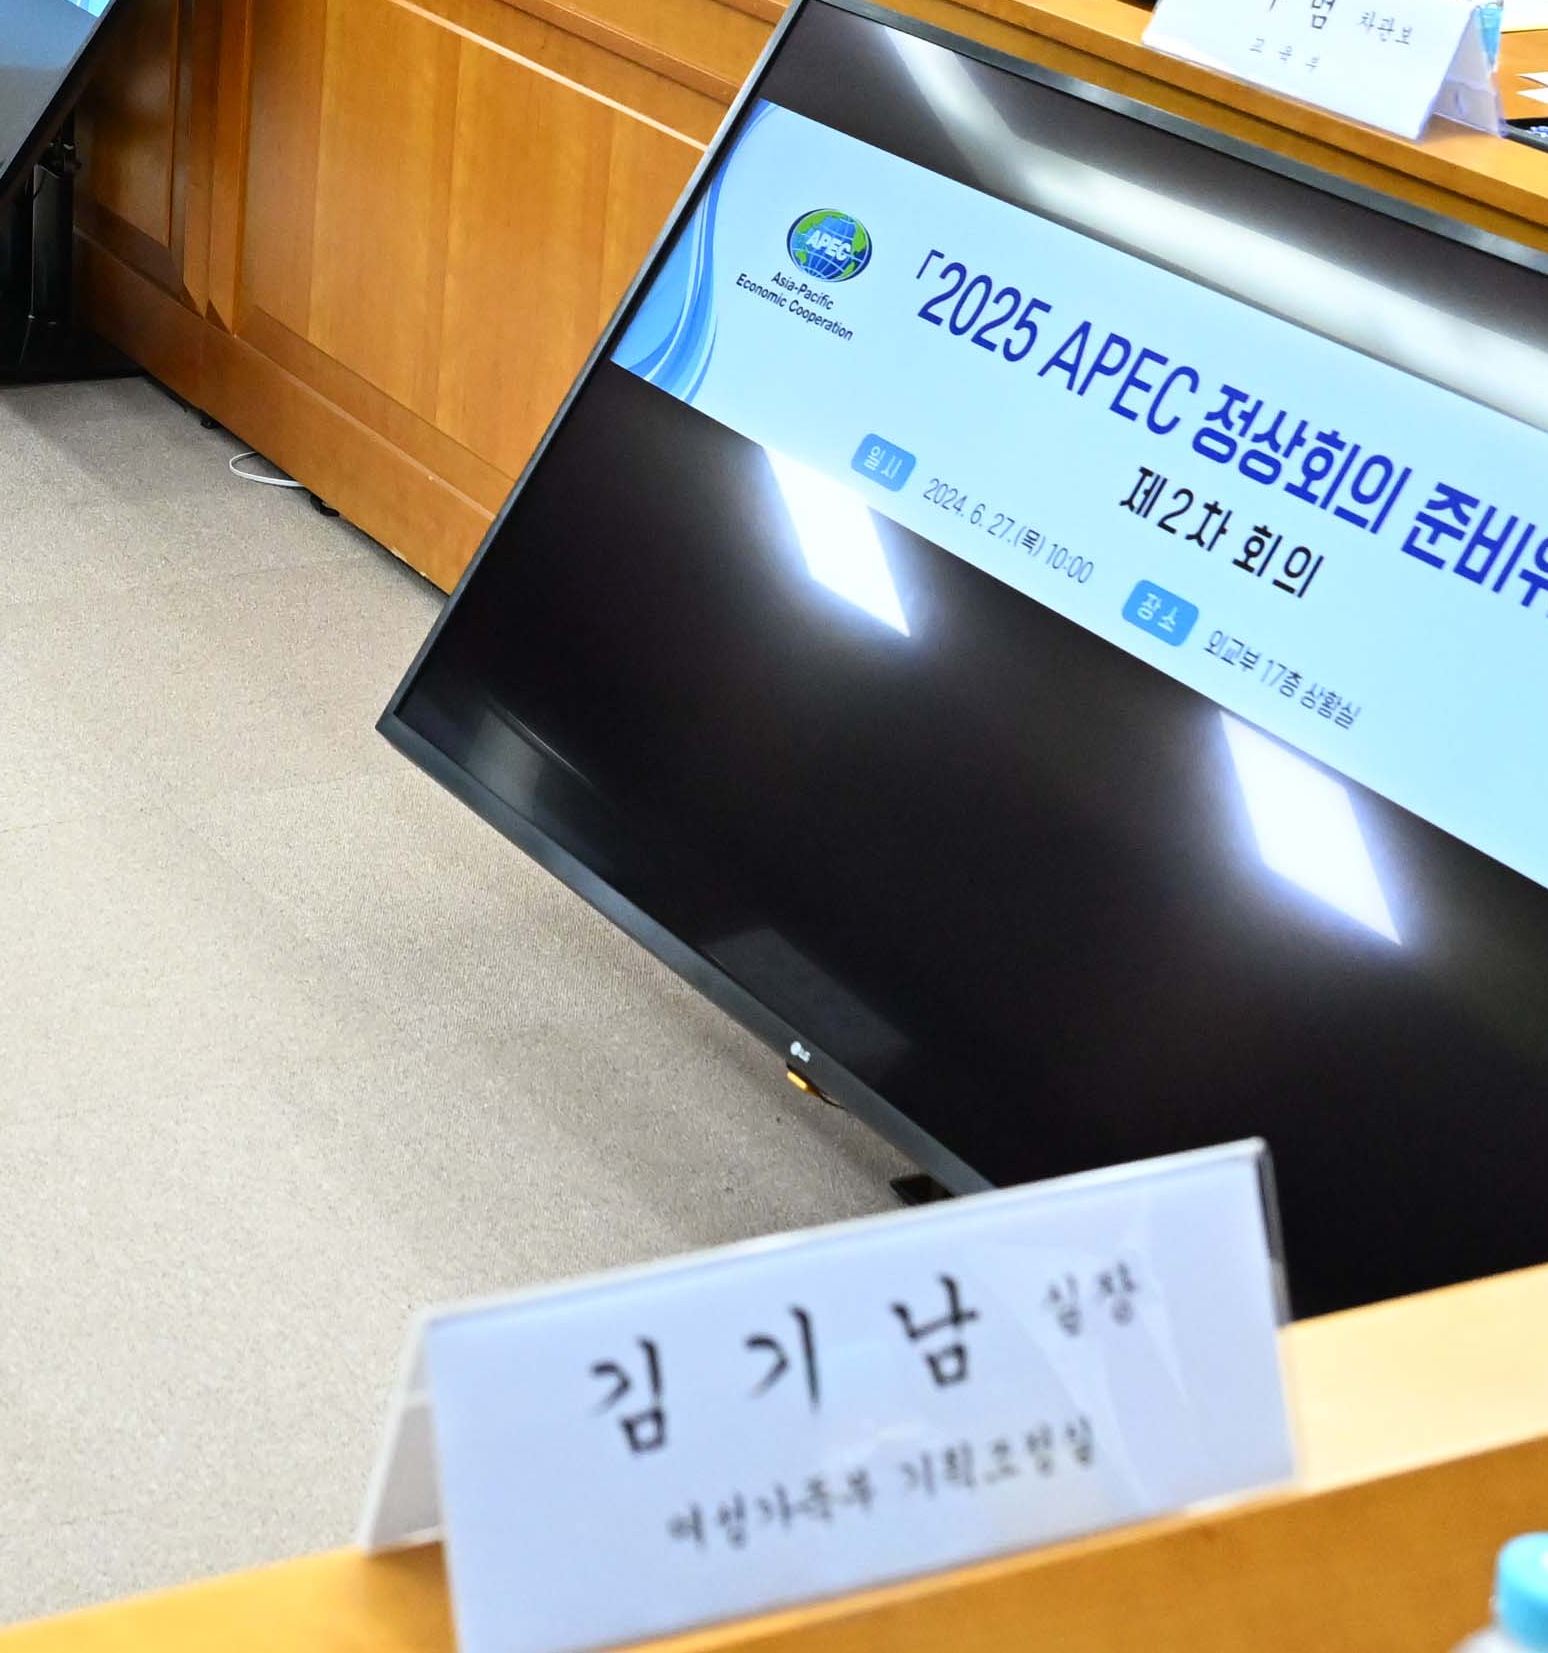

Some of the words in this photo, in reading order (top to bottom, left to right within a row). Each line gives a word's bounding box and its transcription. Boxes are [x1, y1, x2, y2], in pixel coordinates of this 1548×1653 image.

[1249, 37, 1321, 73] 교육부
[1357, 10, 1414, 46] 차관보
[806, 229, 853, 261] APEC
[735, 272, 787, 308] Economic
[788, 299, 854, 342] Cooperation
[770, 271, 835, 311] Asia-Pacific
[1036, 317, 1204, 440] APEC
[1192, 381, 1412, 534] 정상회의
[863, 443, 904, 479] 일시
[922, 476, 971, 519] 2024.
[1045, 543, 1097, 585] 10:00
[1118, 465, 1229, 553] 제2차
[1230, 523, 1326, 600] 회의
[1134, 591, 1179, 634] 장소
[1201, 629, 1263, 674] 외교부
[1265, 657, 1305, 699] 17층
[1300, 679, 1364, 731] 상황실
[586, 1273, 984, 1459] 김기남
[1037, 1259, 1143, 1339] 실장
[665, 1471, 879, 1551] 여성가족부
[900, 1414, 1100, 1504] 기획조정실
